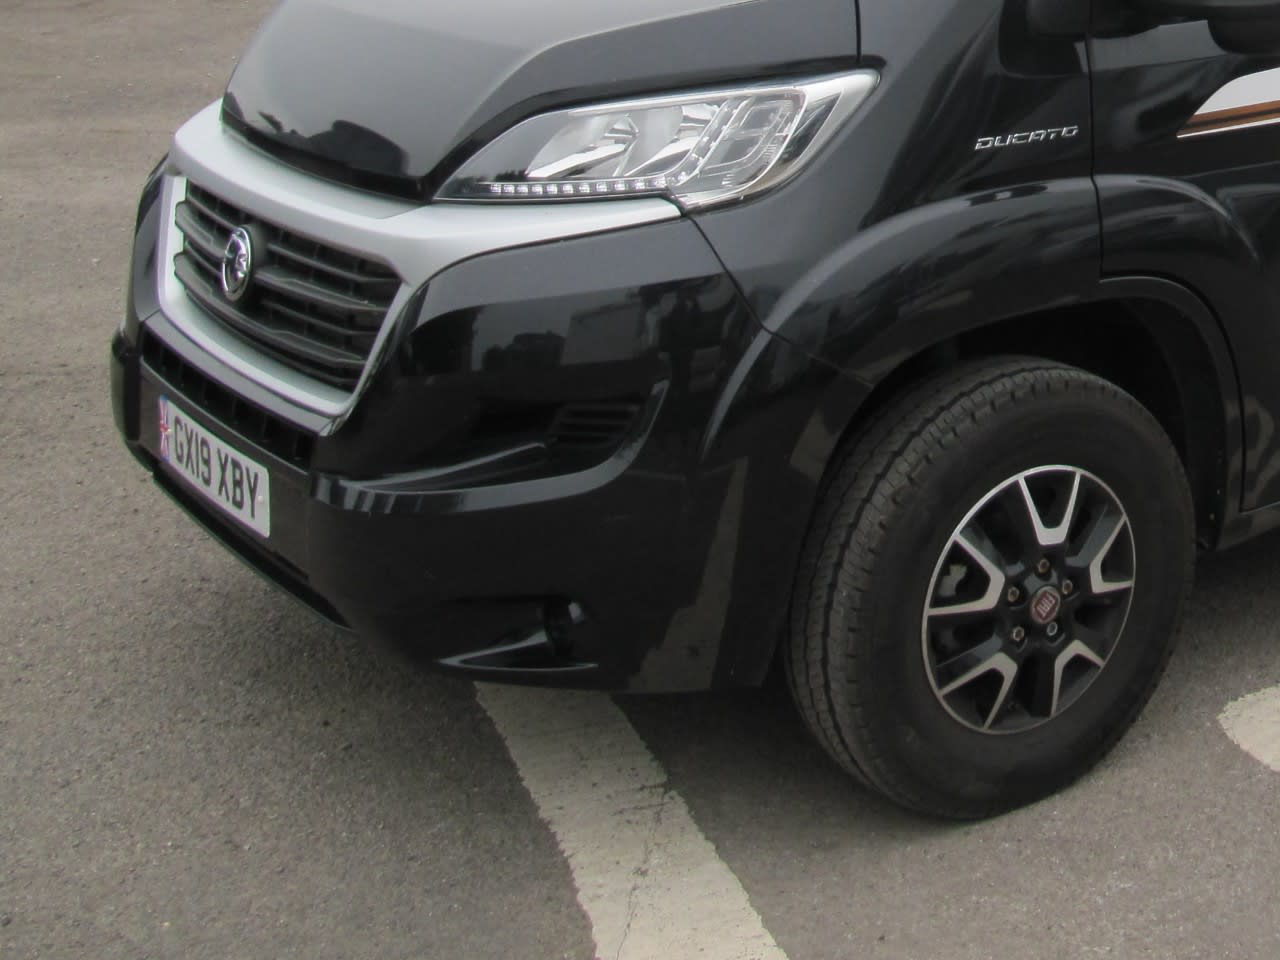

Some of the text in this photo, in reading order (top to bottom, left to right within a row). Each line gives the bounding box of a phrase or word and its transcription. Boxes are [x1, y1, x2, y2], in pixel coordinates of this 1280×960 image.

[975, 125, 1079, 151] DUCATO
[174, 415, 259, 520] GX19 XBY
